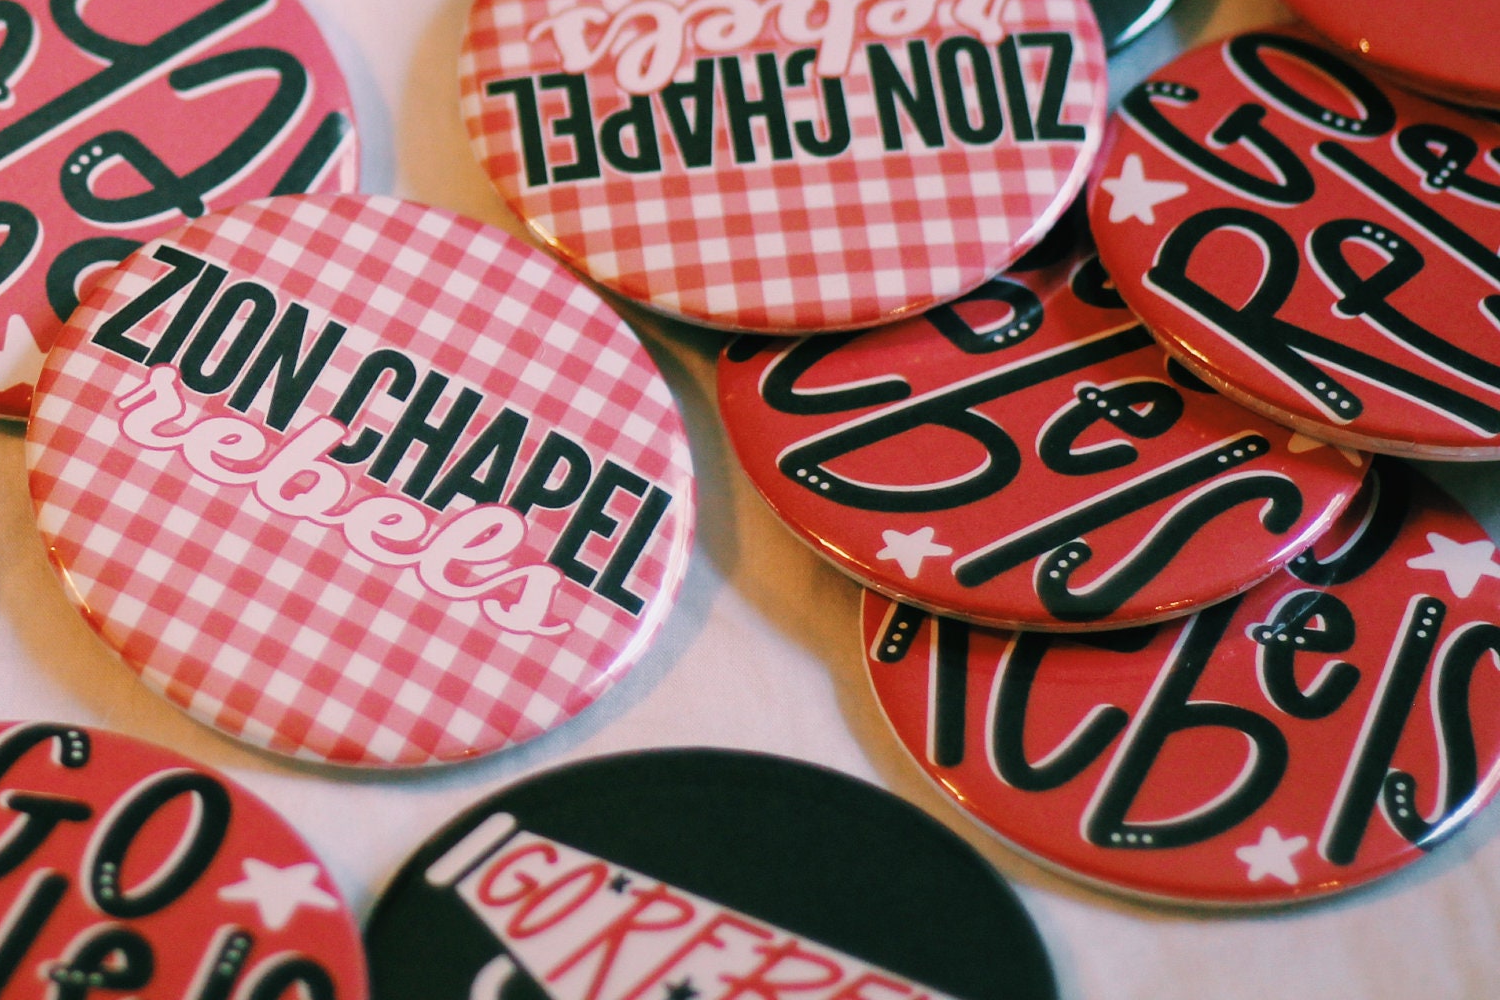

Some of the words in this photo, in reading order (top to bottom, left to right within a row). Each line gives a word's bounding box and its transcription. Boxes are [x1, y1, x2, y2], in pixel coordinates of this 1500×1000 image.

[487, 49, 850, 188] CHAPEL
[866, 30, 1086, 152] ZION
[1120, 32, 1397, 207] GO
[91, 245, 347, 432] ZION
[330, 348, 673, 617] CHAPEL
[116, 362, 572, 636] rebels
[476, 840, 608, 940] GO
